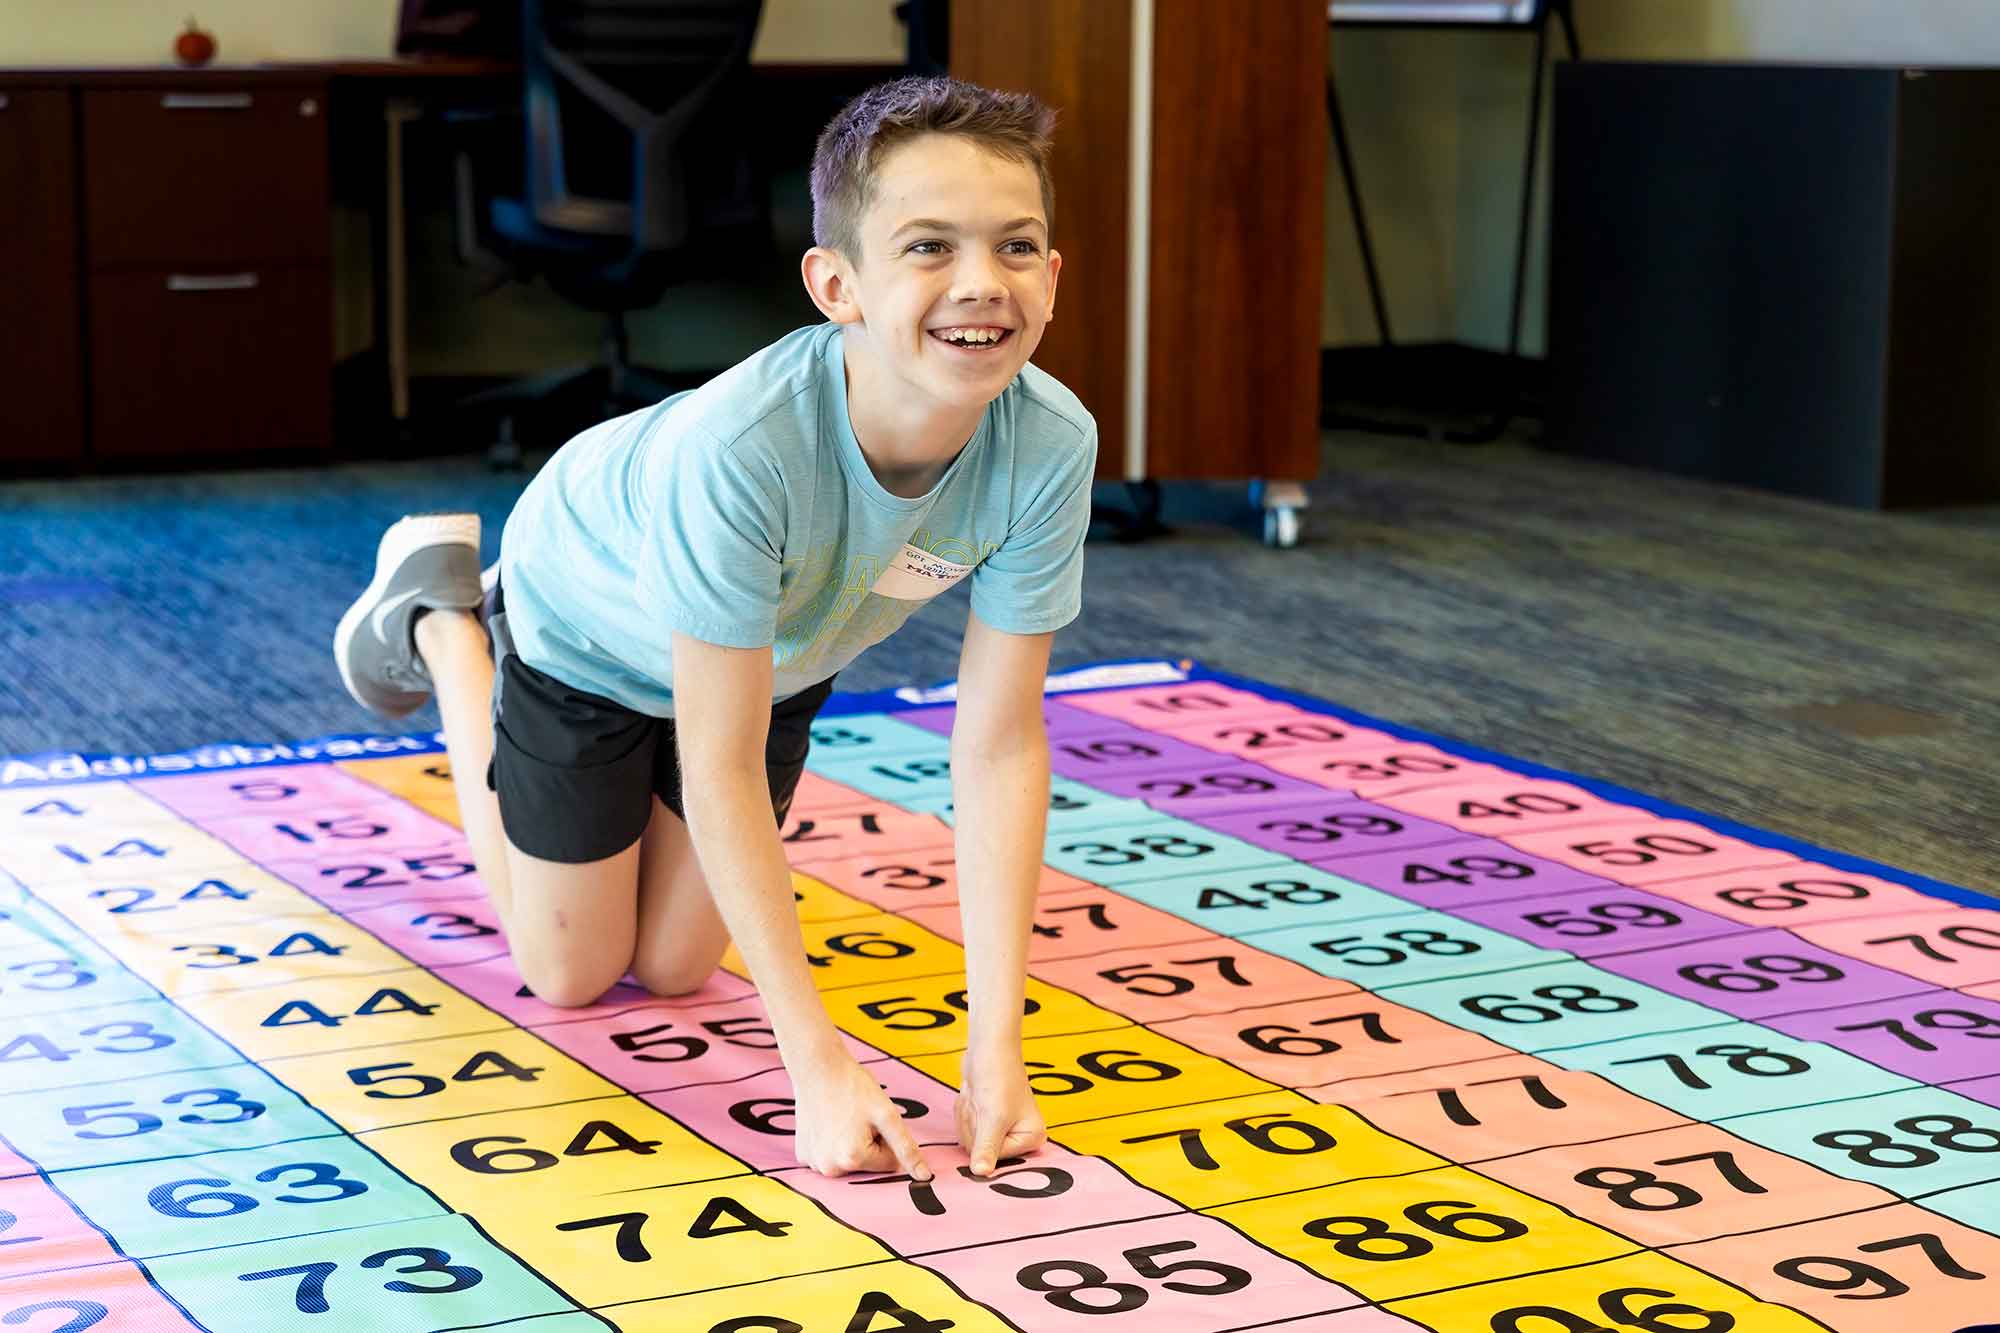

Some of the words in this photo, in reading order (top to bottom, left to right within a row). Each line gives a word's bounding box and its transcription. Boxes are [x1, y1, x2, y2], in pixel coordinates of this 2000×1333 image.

[1136, 692, 1232, 714] 10
[1059, 740, 1162, 763] 19
[1215, 722, 1345, 750] 20
[1138, 772, 1278, 799] 29
[1322, 754, 1458, 782] 30
[22, 799, 85, 817] 4
[229, 779, 299, 801] 5
[1458, 792, 1582, 822] 40
[274, 814, 389, 843] 15
[1258, 811, 1405, 846] 39
[56, 838, 169, 864] 14
[1060, 833, 1216, 866] 38
[1570, 834, 1718, 868] 50
[321, 852, 477, 889] 25
[861, 860, 955, 890] 3
[1400, 853, 1537, 889] 49
[88, 879, 256, 914] 24
[1196, 878, 1342, 915] 48
[1716, 877, 1871, 912] 60
[411, 911, 499, 941] 3
[1519, 901, 1684, 938] 59
[171, 930, 349, 968] 34
[806, 932, 916, 967] 6
[1311, 929, 1483, 966] 58
[1864, 925, 2000, 963] 70
[8, 959, 98, 991] 3
[1097, 956, 1253, 997] 57
[1677, 954, 1846, 993] 69
[261, 987, 440, 1028] 44
[1459, 983, 1639, 1024] 68
[0, 1020, 177, 1063] 43
[1238, 1012, 1402, 1057] 67
[1834, 1008, 2000, 1053] 79
[345, 1050, 545, 1099] 54
[1611, 1044, 1811, 1090] 78
[62, 1088, 266, 1139] 53
[1385, 1075, 1568, 1127] 77
[450, 1120, 663, 1175] 64
[1120, 1113, 1338, 1171] 76
[1812, 1114, 2000, 1169] 88
[147, 1162, 369, 1218] 63
[848, 1158, 1074, 1216] 75
[1573, 1151, 1769, 1212] 87
[555, 1196, 794, 1263] 74
[1303, 1200, 1529, 1261] 86
[237, 1246, 484, 1314] 73
[1016, 1240, 1252, 1314] 85
[1773, 1233, 1987, 1300] 97
[1490, 1287, 1736, 1333] 96
